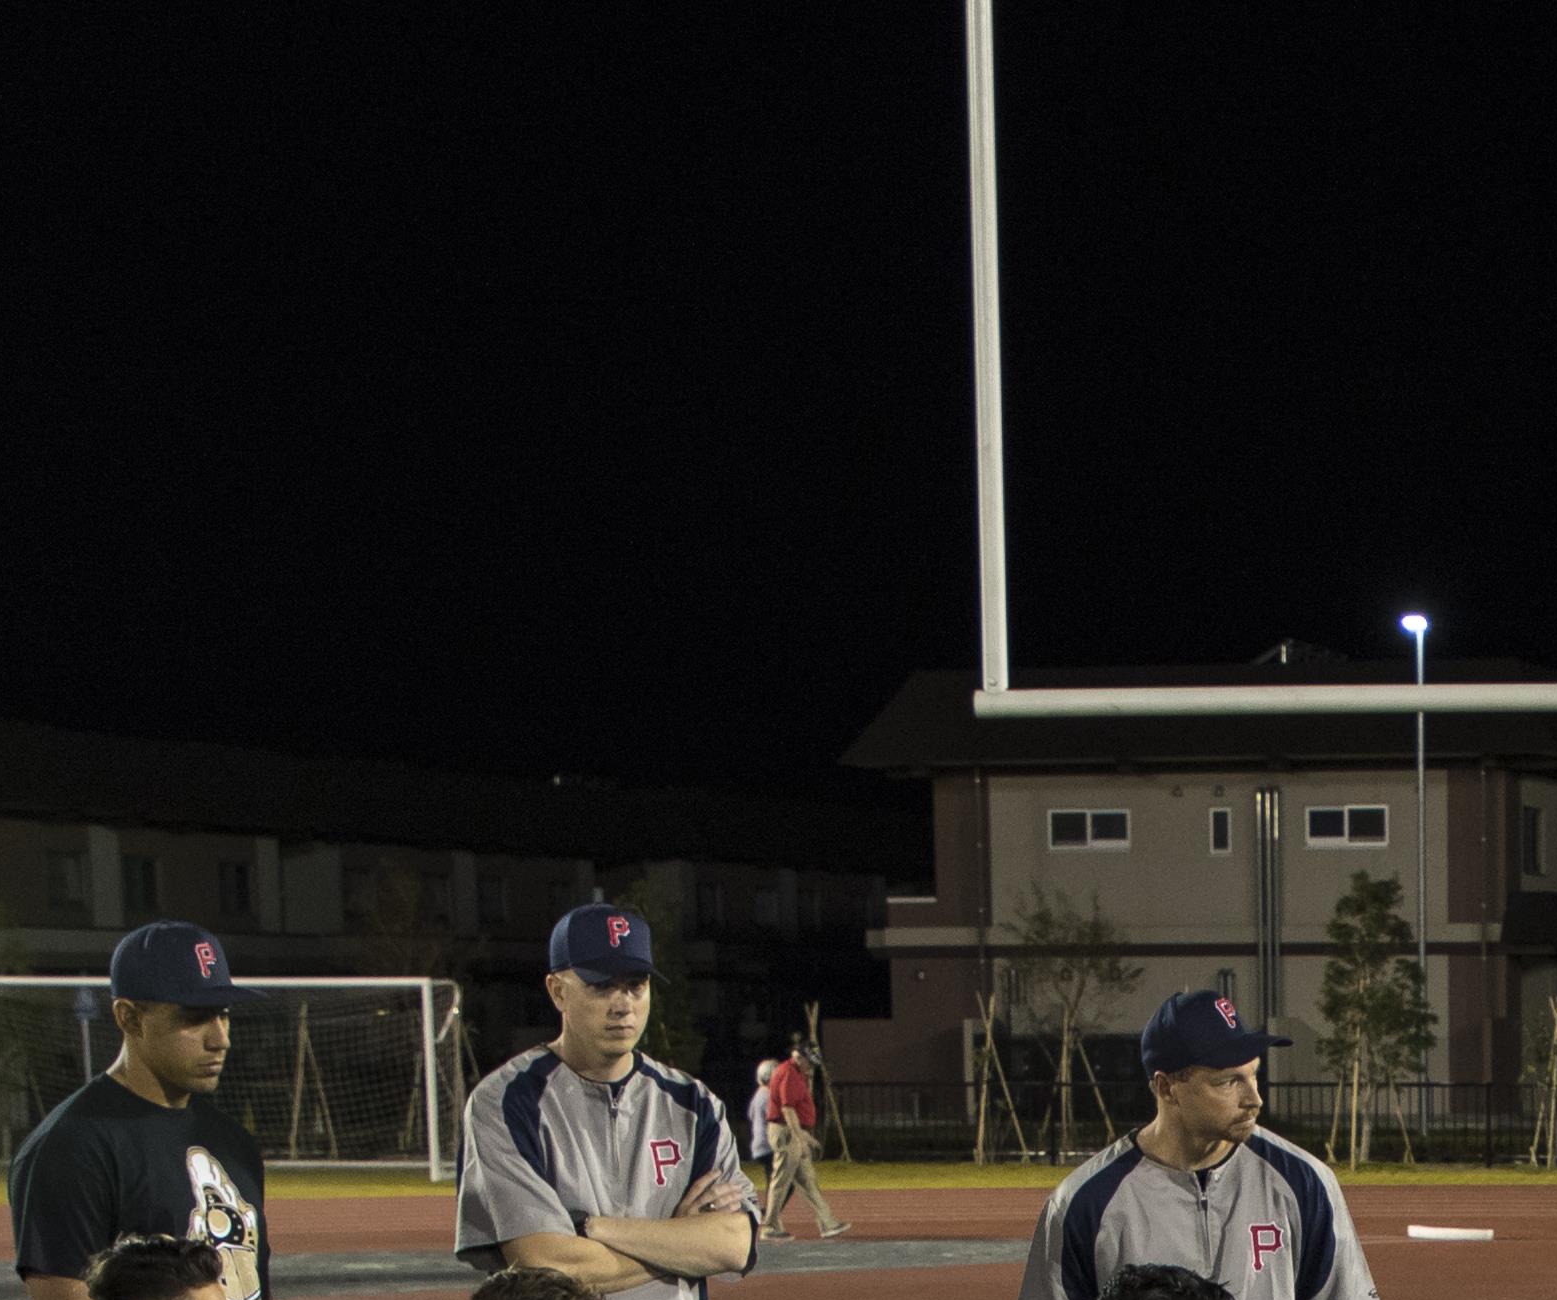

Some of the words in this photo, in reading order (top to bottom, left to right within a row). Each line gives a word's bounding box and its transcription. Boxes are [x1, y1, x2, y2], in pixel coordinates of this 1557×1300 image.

[607, 914, 630, 947] P
[194, 942, 217, 978] P
[1214, 997, 1237, 1028] P
[650, 1139, 682, 1185] P
[1250, 1223, 1283, 1269] P
